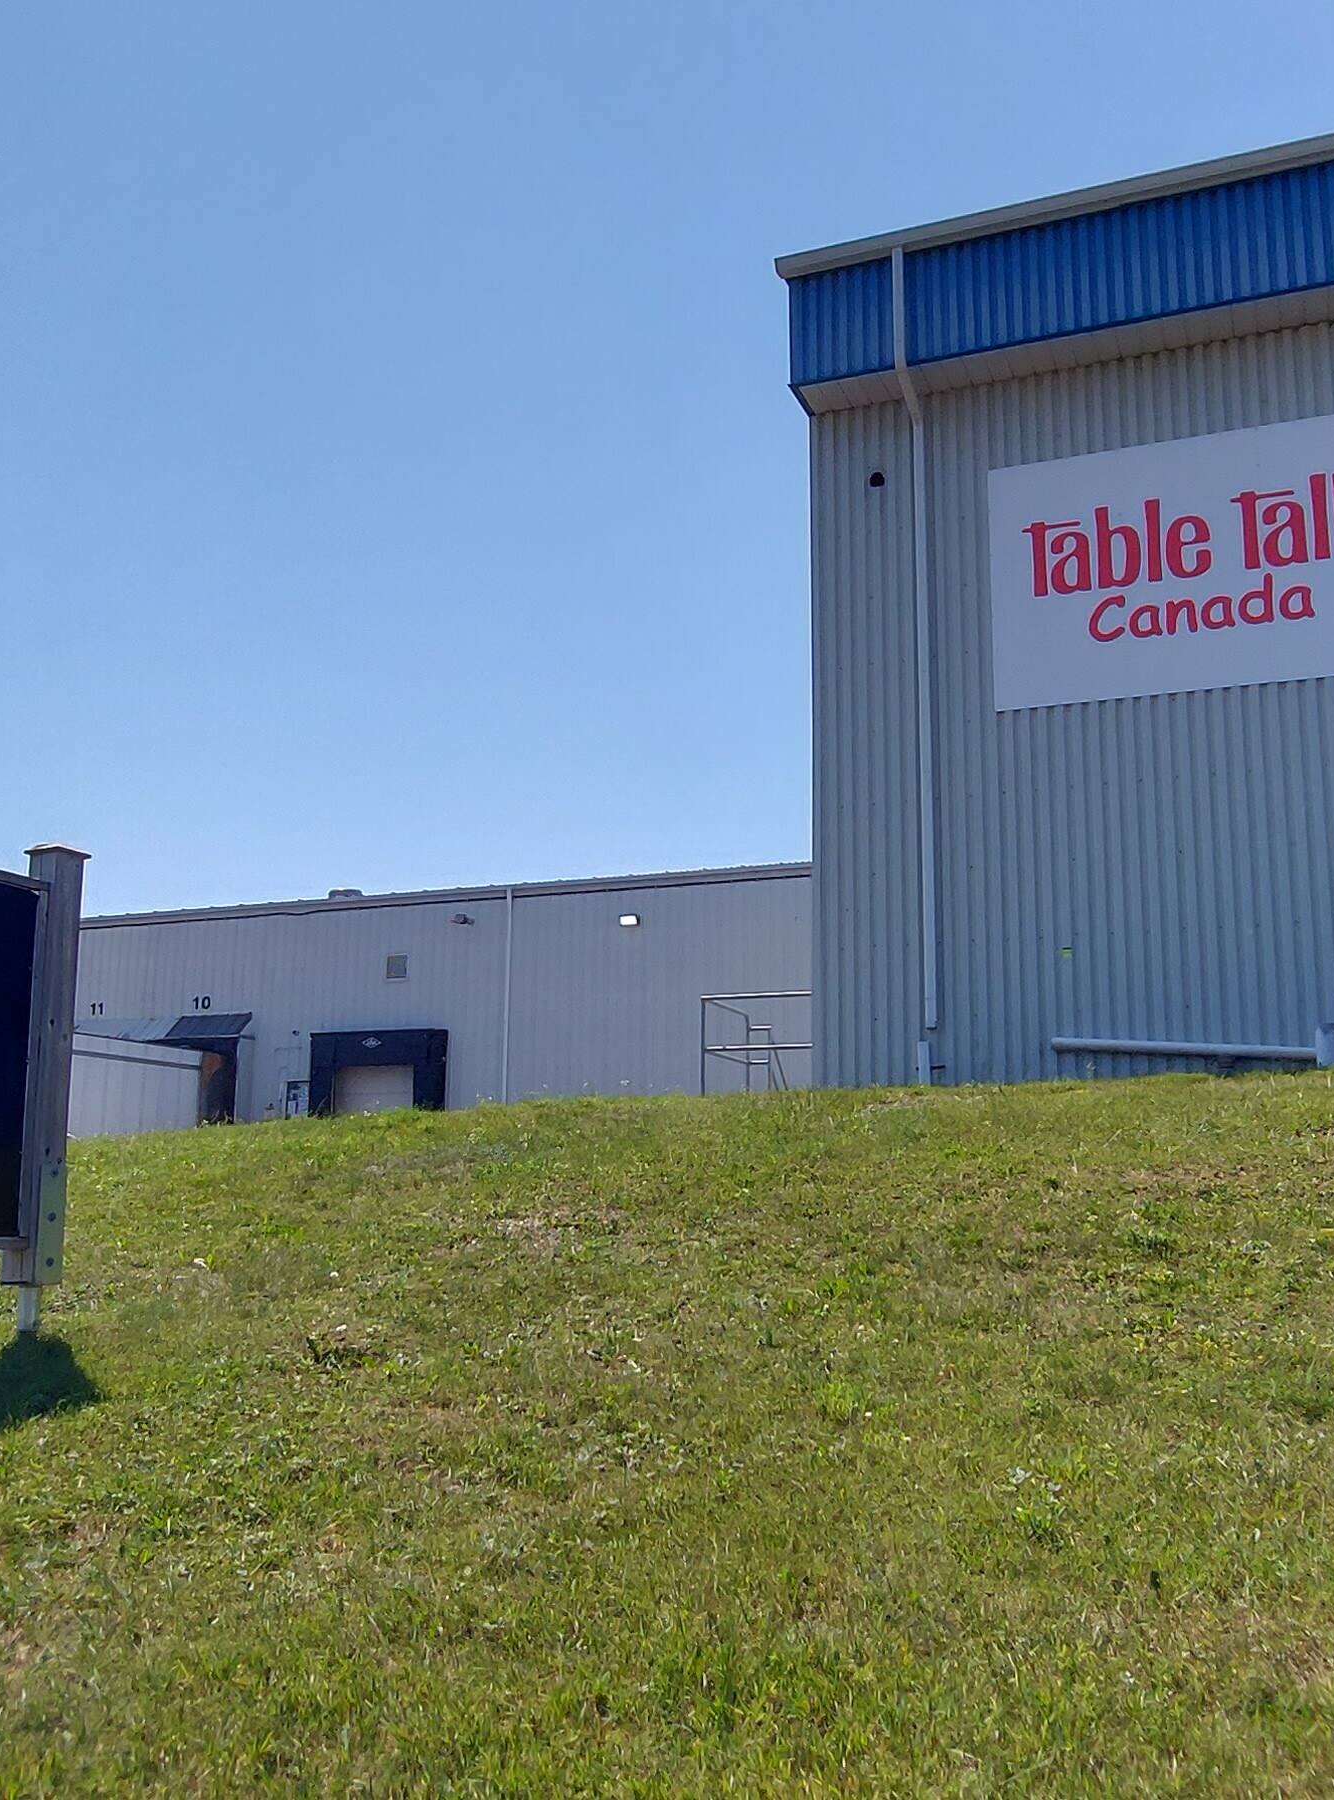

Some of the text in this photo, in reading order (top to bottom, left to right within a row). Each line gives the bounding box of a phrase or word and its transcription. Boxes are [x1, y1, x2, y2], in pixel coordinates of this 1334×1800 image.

[1020, 498, 1213, 597] Table
[1088, 572, 1316, 643] Canada
[90, 1002, 104, 1016] 11
[192, 995, 211, 1010] 10
